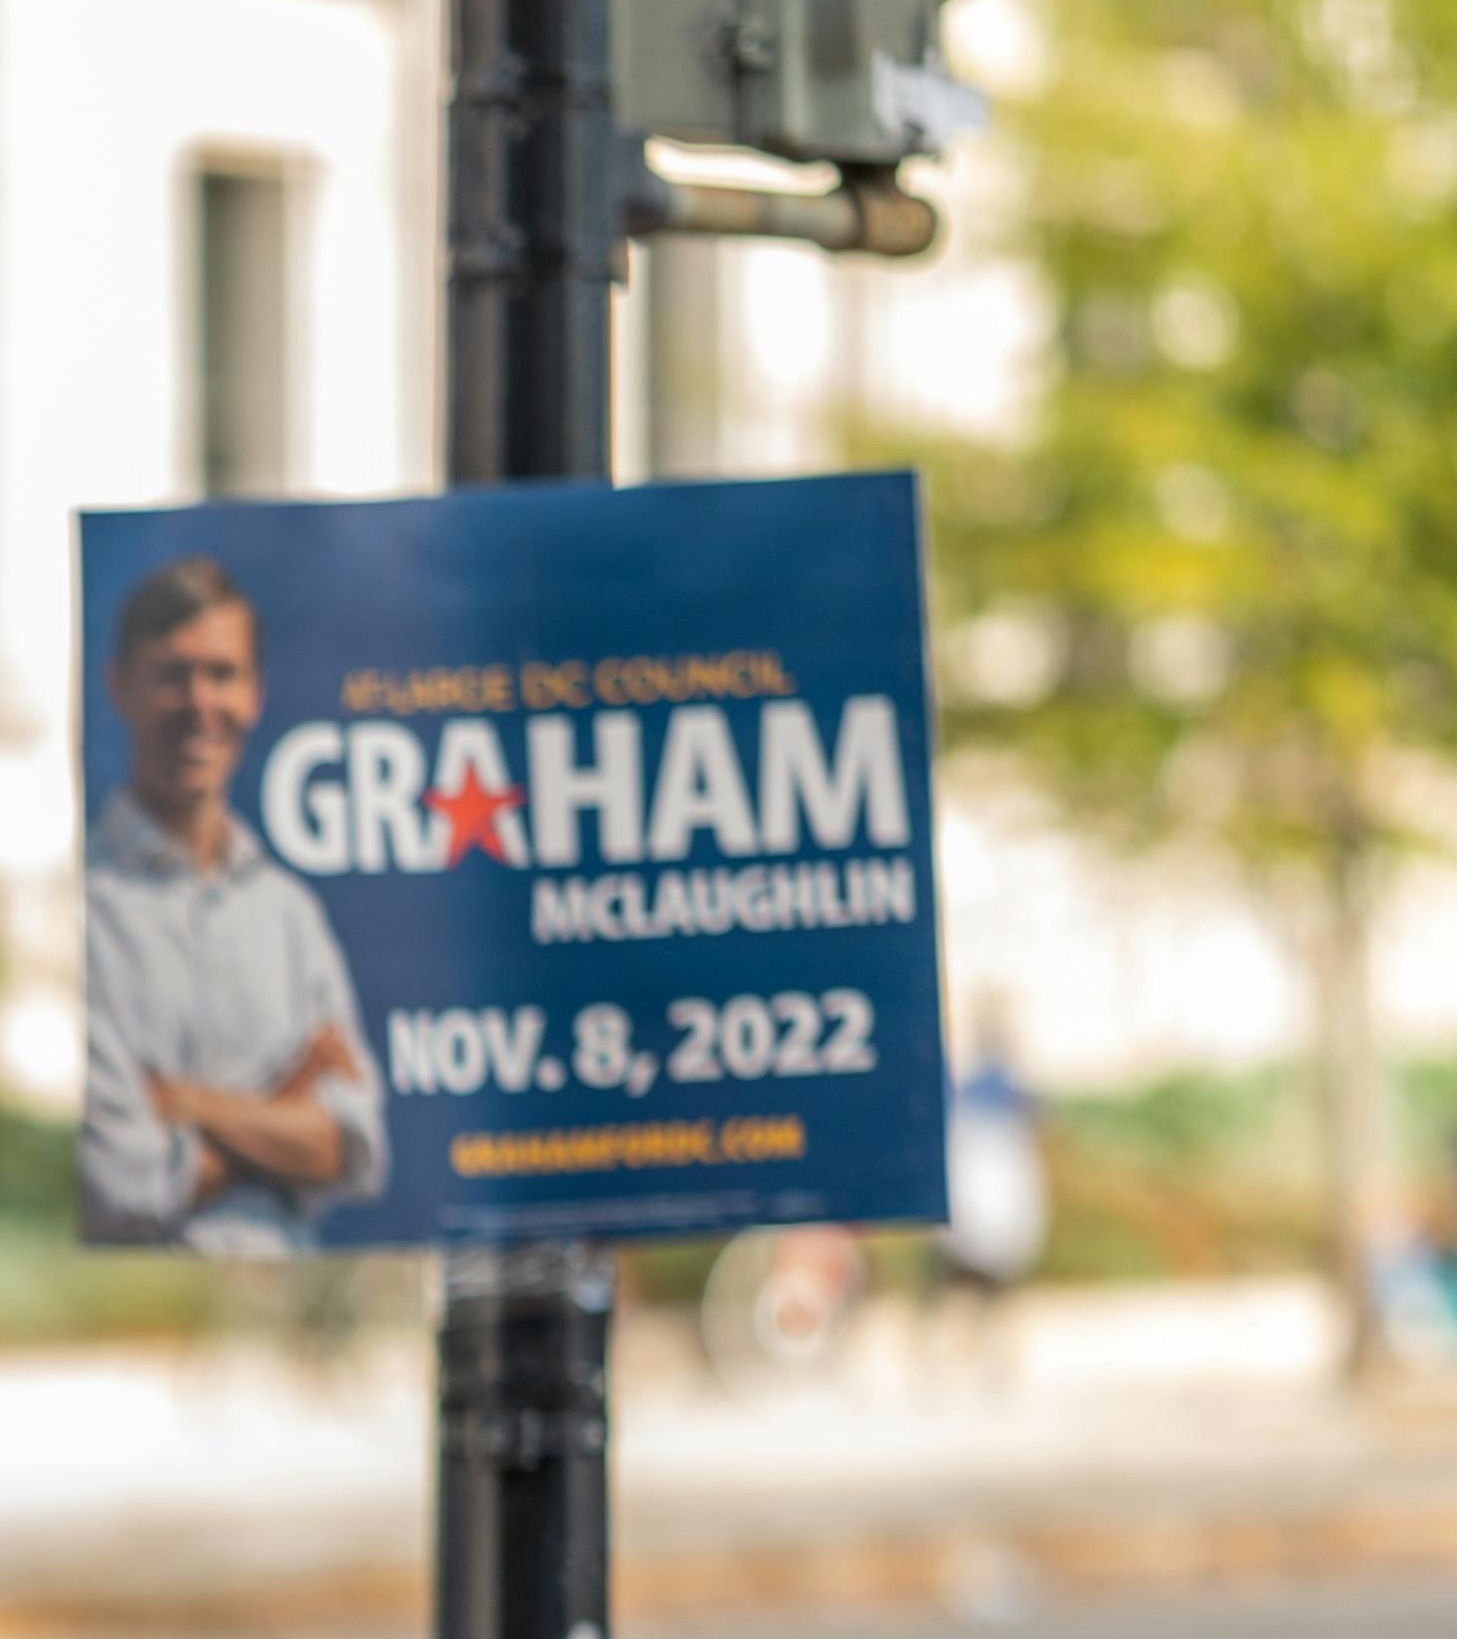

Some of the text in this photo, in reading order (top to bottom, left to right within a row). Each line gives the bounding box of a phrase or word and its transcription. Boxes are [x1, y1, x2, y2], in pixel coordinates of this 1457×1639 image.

[520, 659, 593, 709] DC
[593, 648, 798, 706] COUNCIL
[260, 693, 912, 875] GRAHAM
[530, 857, 916, 944] MCLAUGHLIN
[389, 987, 878, 1098] NOV. 8, 2022
